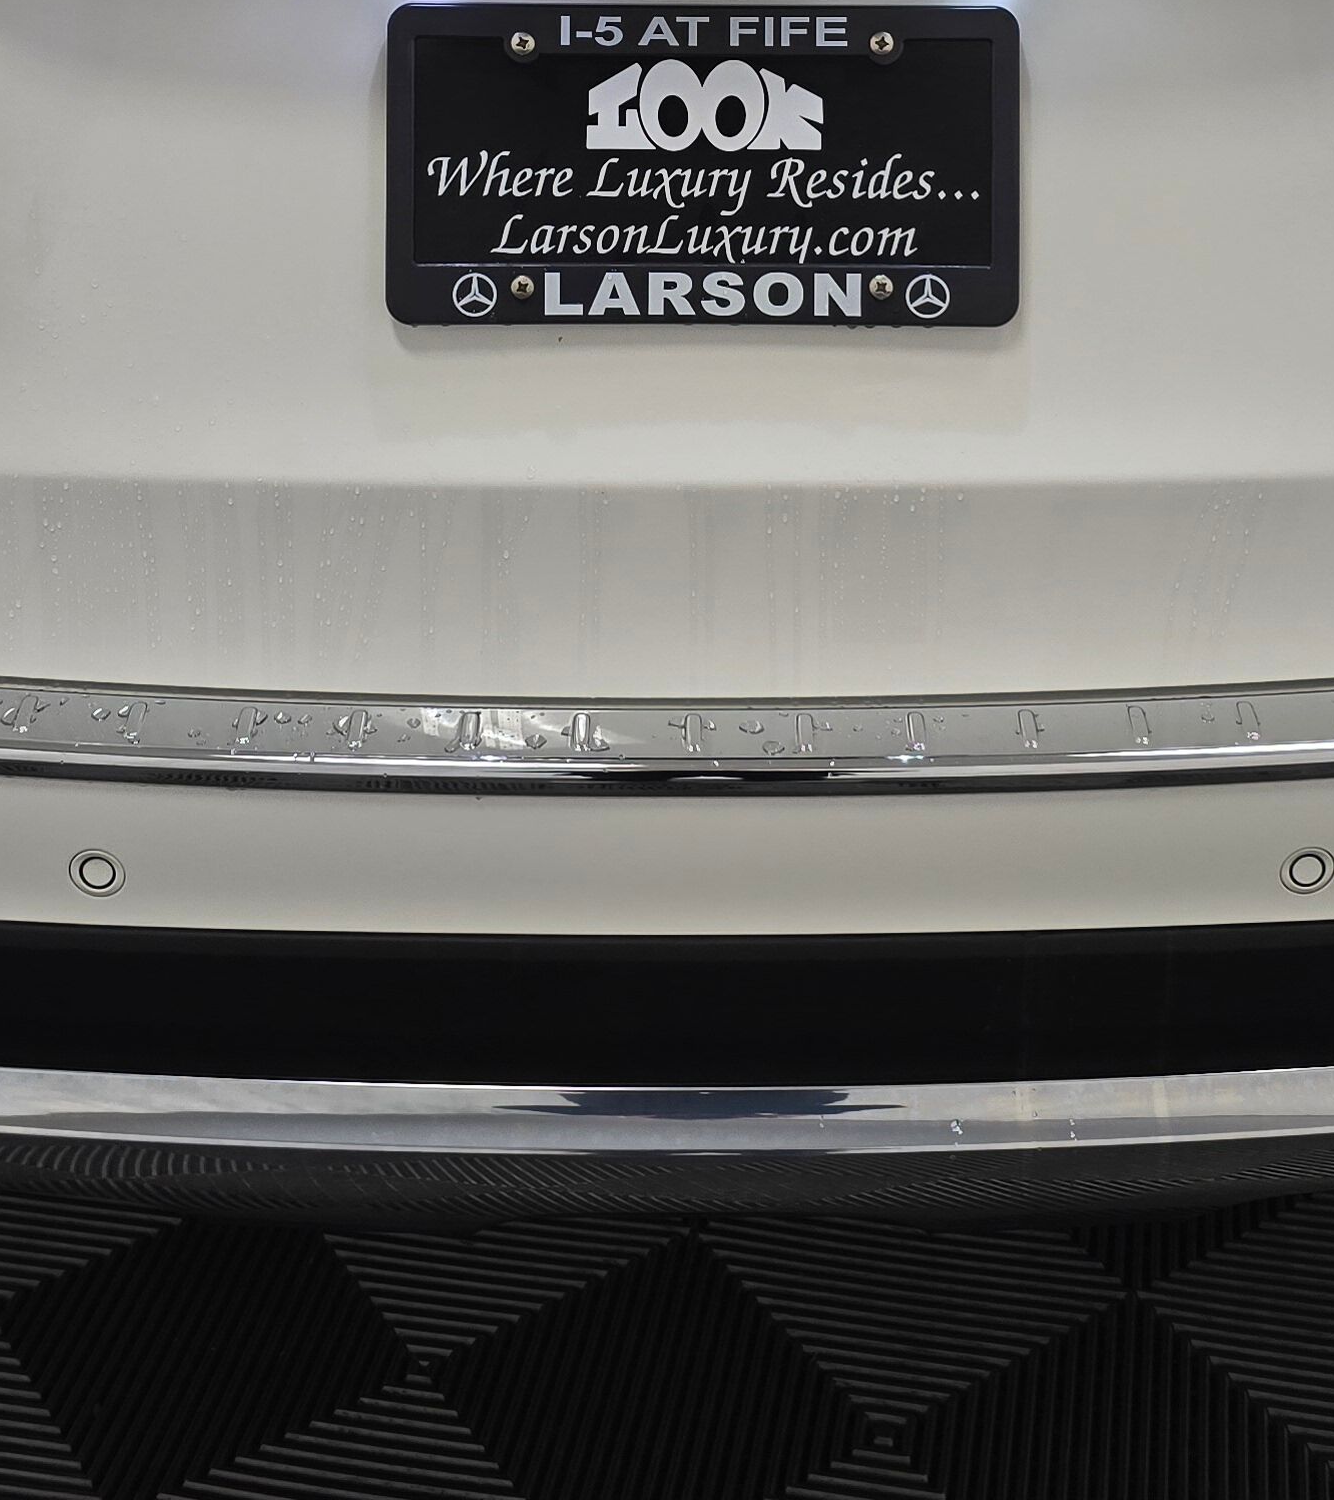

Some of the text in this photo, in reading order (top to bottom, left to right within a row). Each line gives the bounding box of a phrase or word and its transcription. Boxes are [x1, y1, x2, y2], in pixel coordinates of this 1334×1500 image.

[559, 16, 848, 47] I-5 AT FIFE
[586, 59, 824, 151] LOOK
[427, 150, 981, 215] Where Luxury Resides...
[490, 214, 918, 264] LarsonLuxury.com
[543, 271, 863, 317] LARSON
